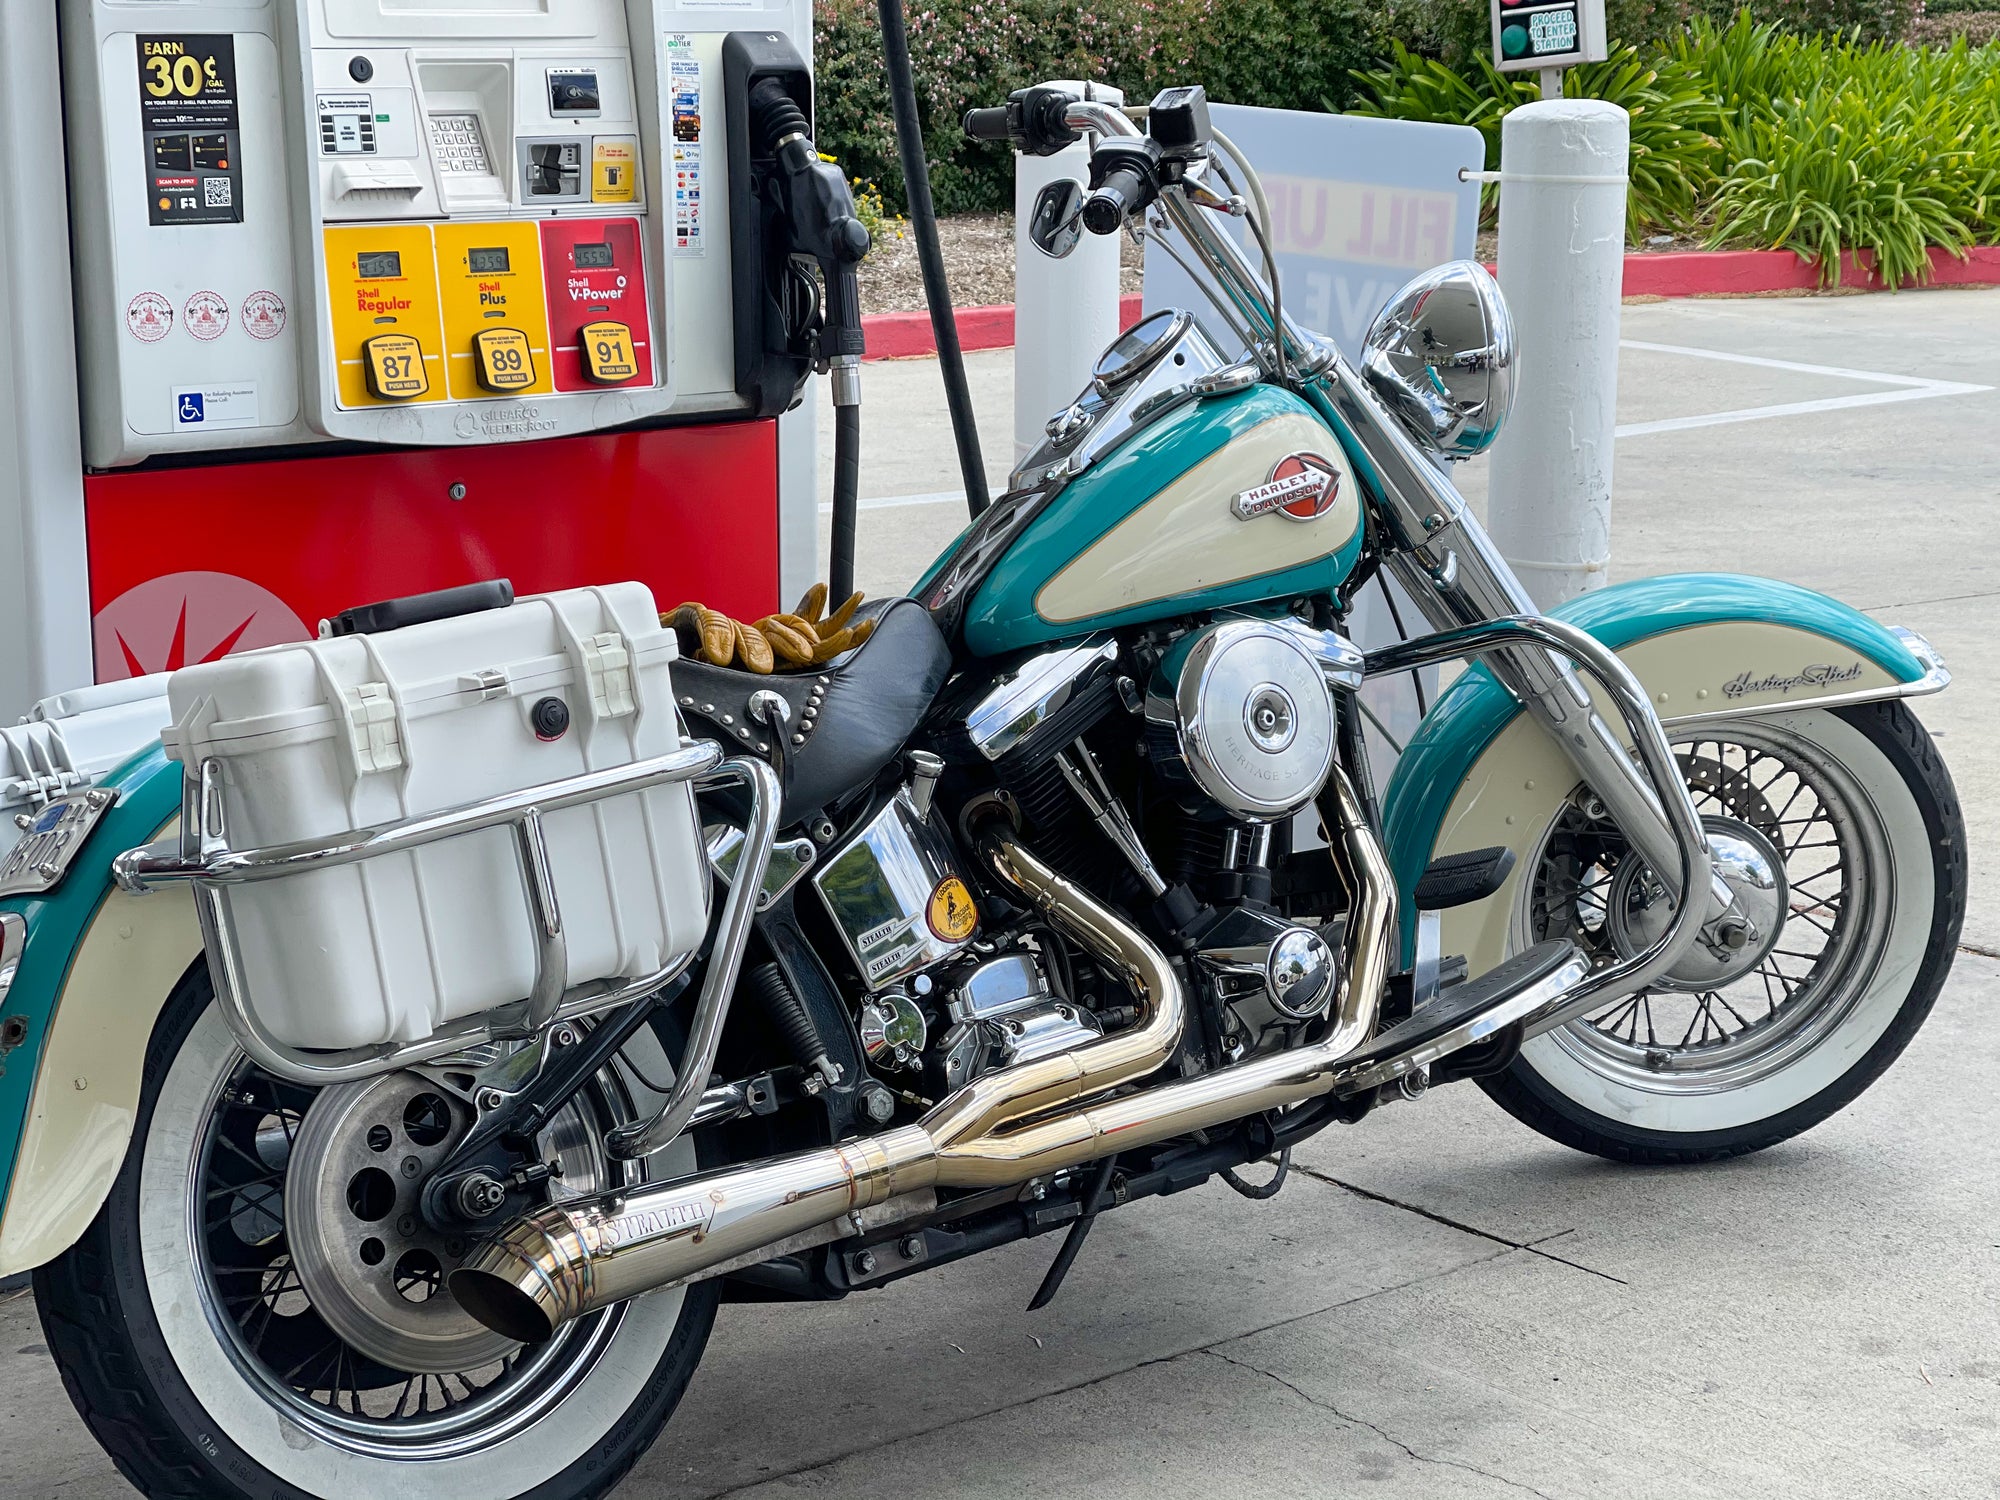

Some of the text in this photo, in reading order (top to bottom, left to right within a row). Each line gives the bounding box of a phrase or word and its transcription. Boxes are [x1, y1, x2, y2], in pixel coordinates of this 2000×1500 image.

[1532, 11, 1573, 26] PROCEED
[1531, 24, 1576, 38] TO ENTER
[144, 42, 184, 55] EARN
[1535, 36, 1573, 51] STATION
[478, 282, 500, 292] Shell
[568, 278, 589, 288] Shell
[356, 288, 380, 298] Shell
[480, 292, 506, 306] Plus
[568, 288, 624, 301] V-Power
[358, 296, 412, 314] Regular
[491, 348, 522, 372] 89
[596, 341, 624, 364] 91
[382, 355, 412, 378] 87
[480, 406, 538, 422] GILBARCO
[481, 420, 558, 436] VEEDER-ROOT
[1250, 482, 1323, 513] DAVIDSON
[1722, 670, 1803, 699] Heritage
[1226, 735, 1280, 782] HERITAGE
[862, 925, 892, 948] STEALTH
[870, 949, 902, 973] STEALTH
[606, 1202, 706, 1246] STEALTH
